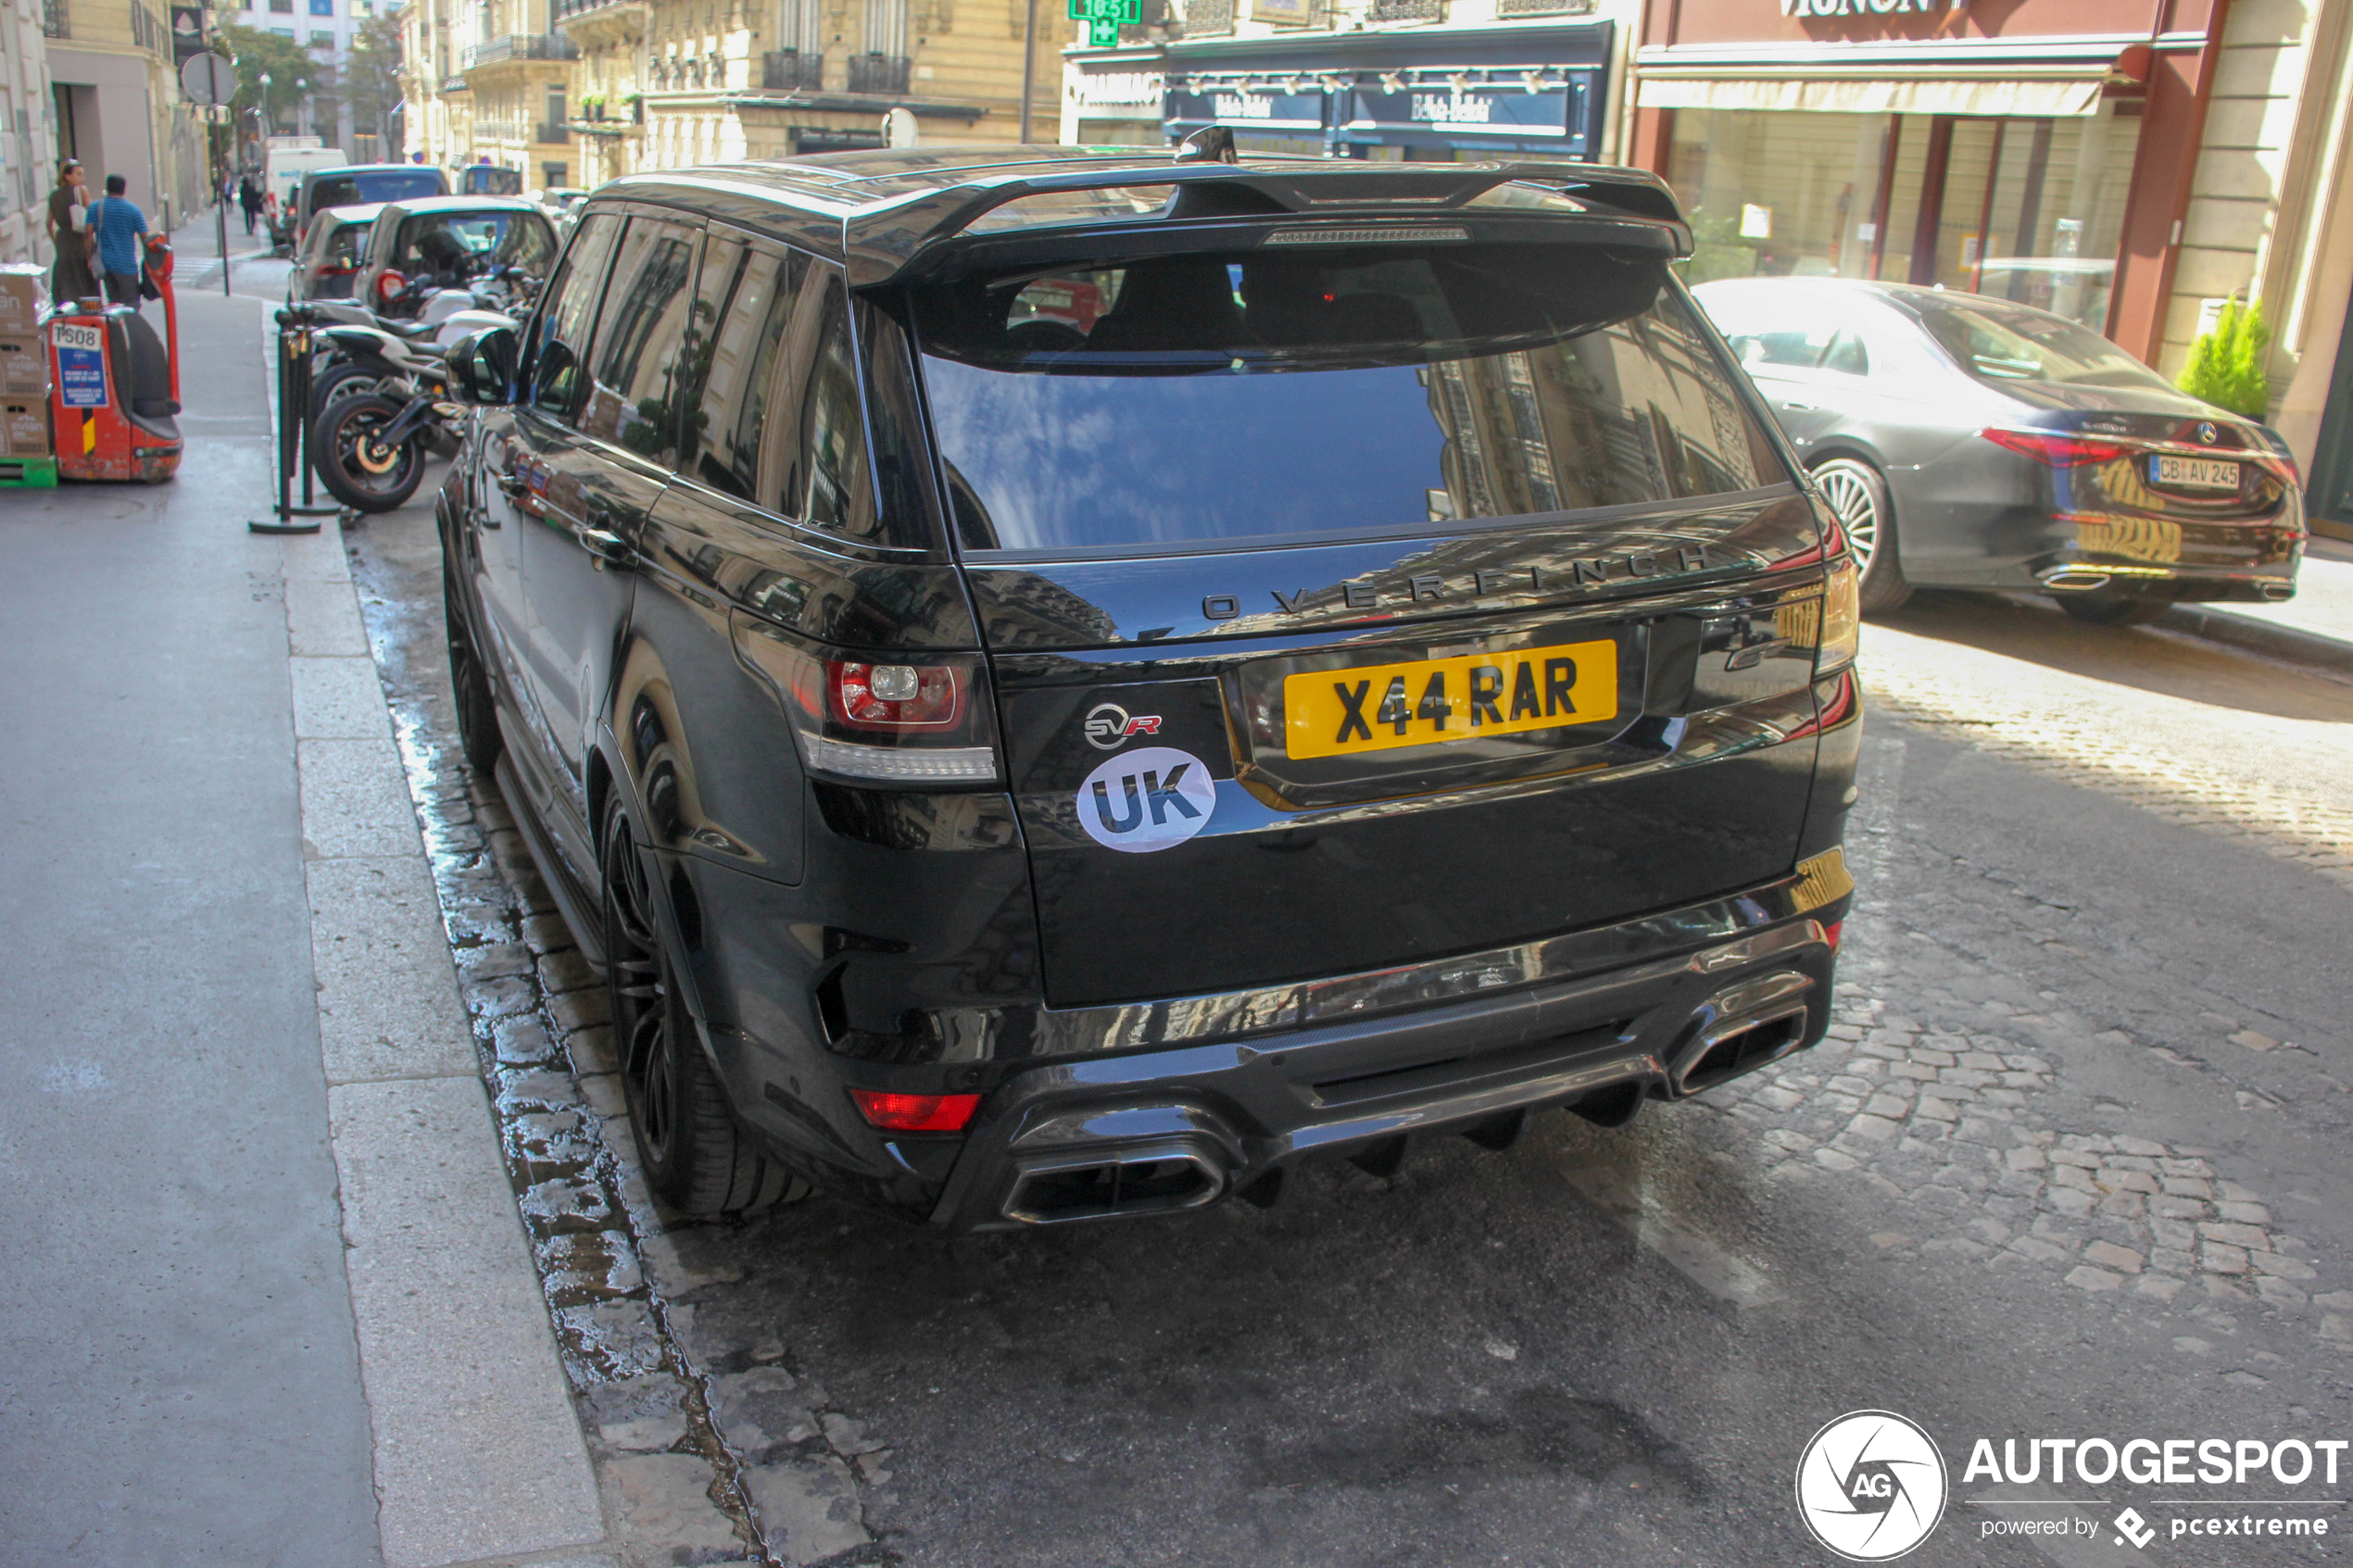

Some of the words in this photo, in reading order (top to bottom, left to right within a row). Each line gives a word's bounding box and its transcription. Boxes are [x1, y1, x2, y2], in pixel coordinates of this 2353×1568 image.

[2160, 459, 2180, 480] CB
[2190, 461, 2208, 482] AV
[2212, 464, 2237, 484] 245
[1202, 545, 1709, 621] OVERFINCH
[1085, 715, 1163, 737] SVR
[1334, 671, 1453, 744] X44
[1468, 656, 1578, 727] RAR
[1091, 762, 1203, 834] UK
